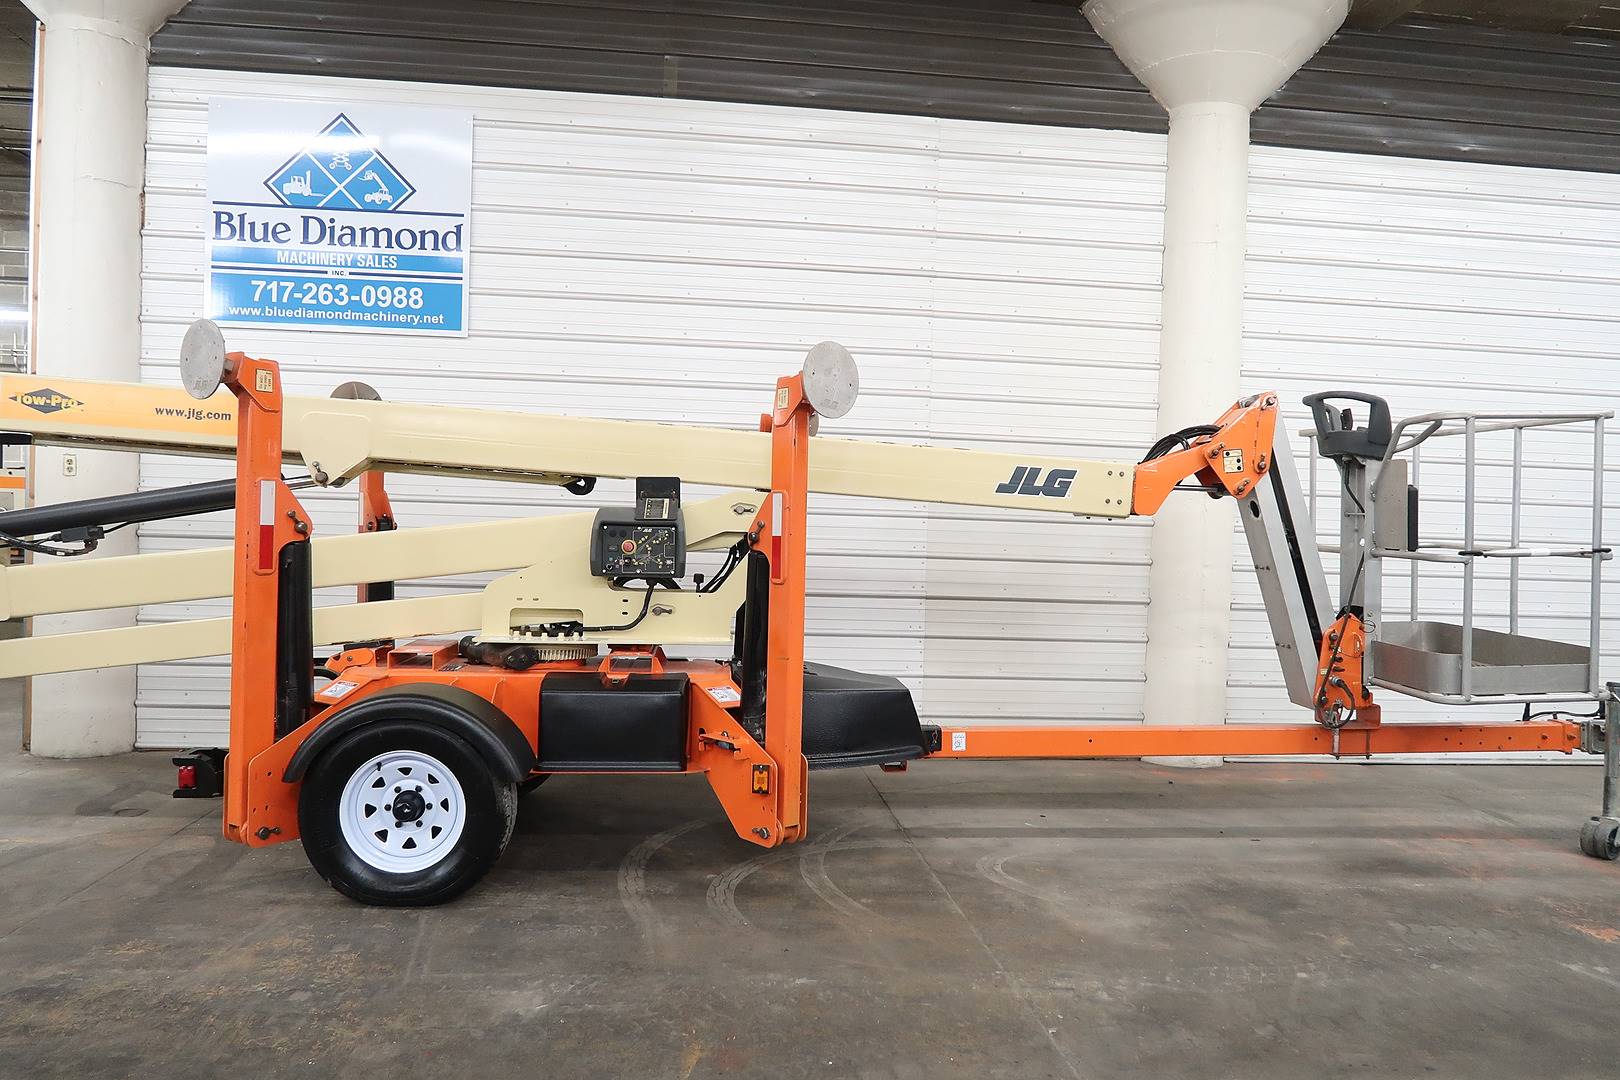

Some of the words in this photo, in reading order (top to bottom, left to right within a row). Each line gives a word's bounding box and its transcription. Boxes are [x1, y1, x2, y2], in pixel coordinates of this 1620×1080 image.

[212, 210, 291, 243] Blue
[300, 215, 464, 252] Diamond
[277, 251, 352, 266] MACHINERY
[357, 254, 398, 268] SALES
[251, 280, 424, 309] 717-263-0988
[229, 306, 444, 325] www.bluediamondmachinery.net
[15, 392, 76, 409] Tow-Pro
[155, 406, 232, 421] www.jlg.com
[995, 466, 1077, 498] JLG
